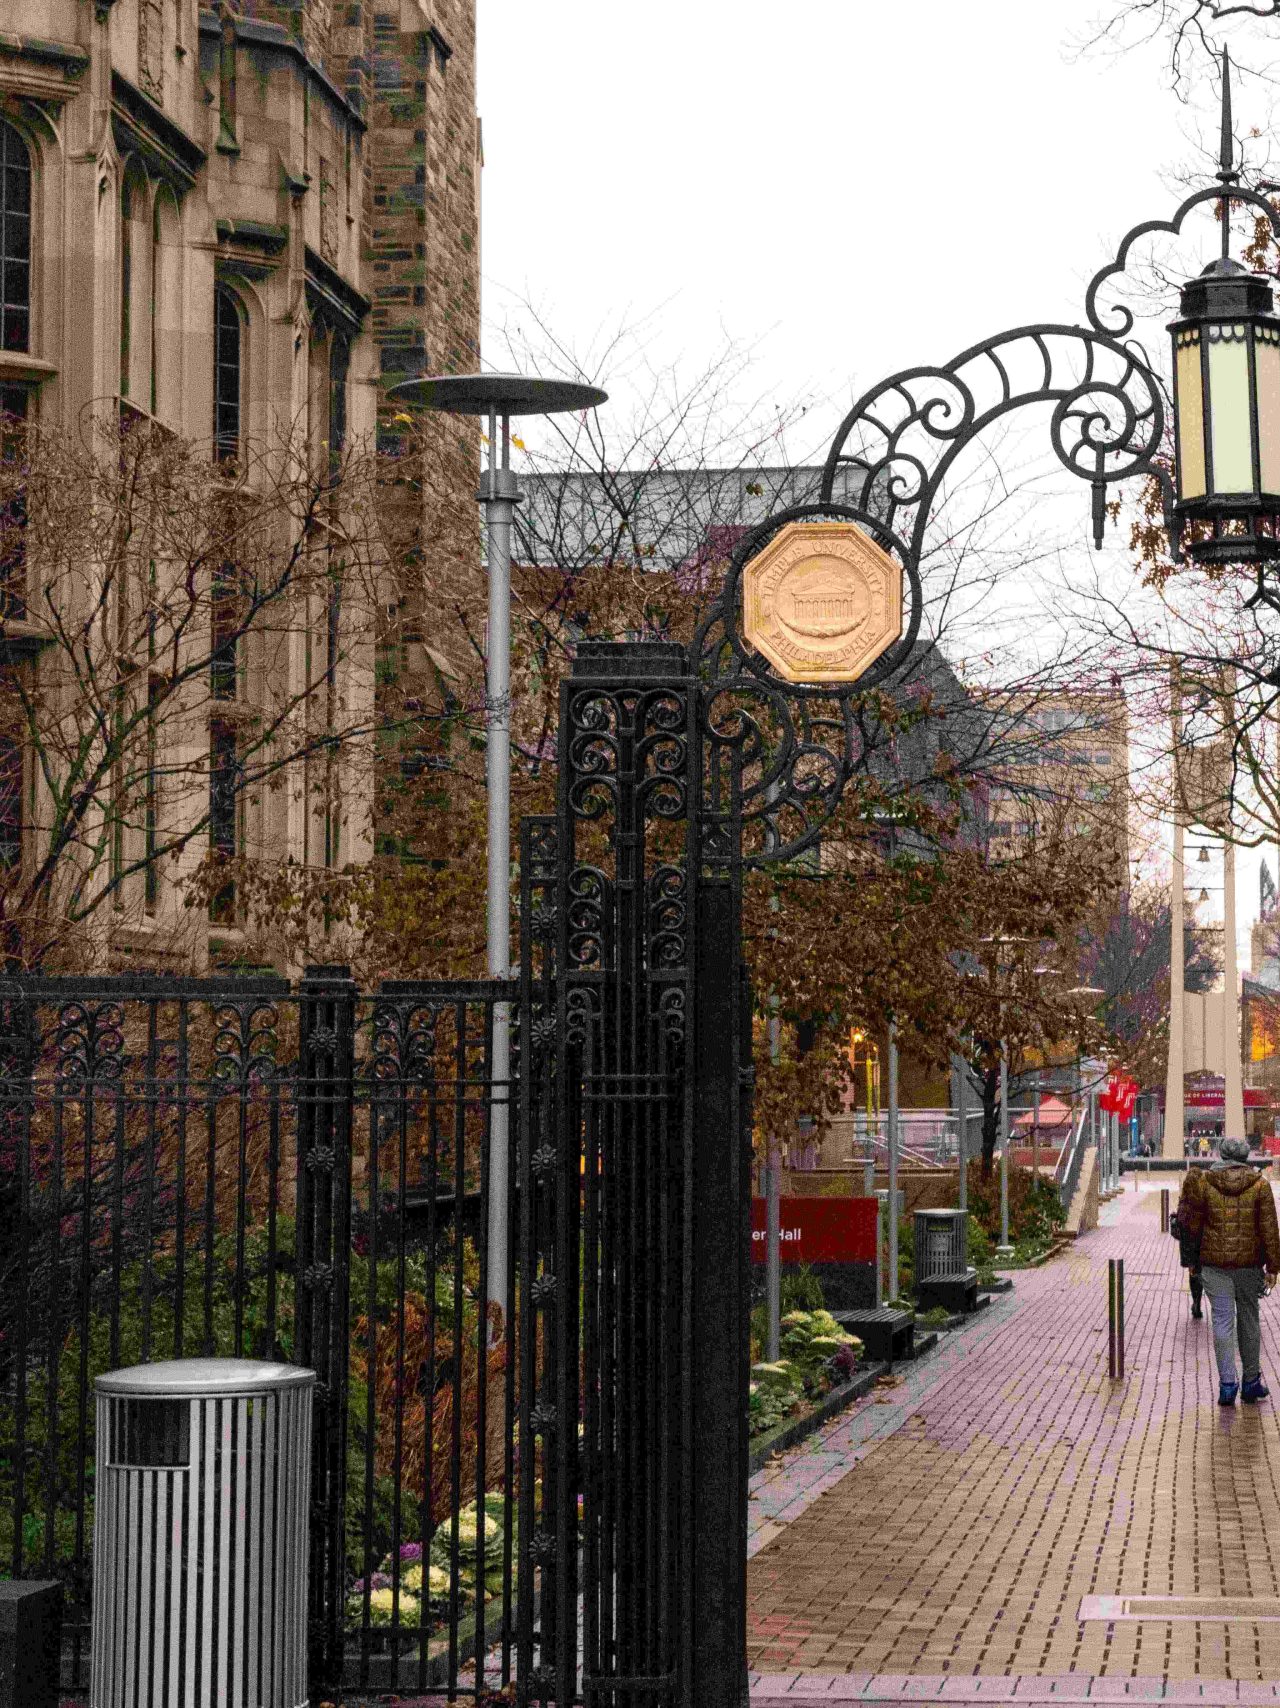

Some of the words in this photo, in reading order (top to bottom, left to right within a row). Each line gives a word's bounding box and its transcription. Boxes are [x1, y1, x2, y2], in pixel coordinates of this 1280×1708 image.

[761, 546, 805, 601] TEMPLE
[811, 541, 884, 598] UNIVERSITY
[770, 630, 876, 664] PHILADELPHIA
